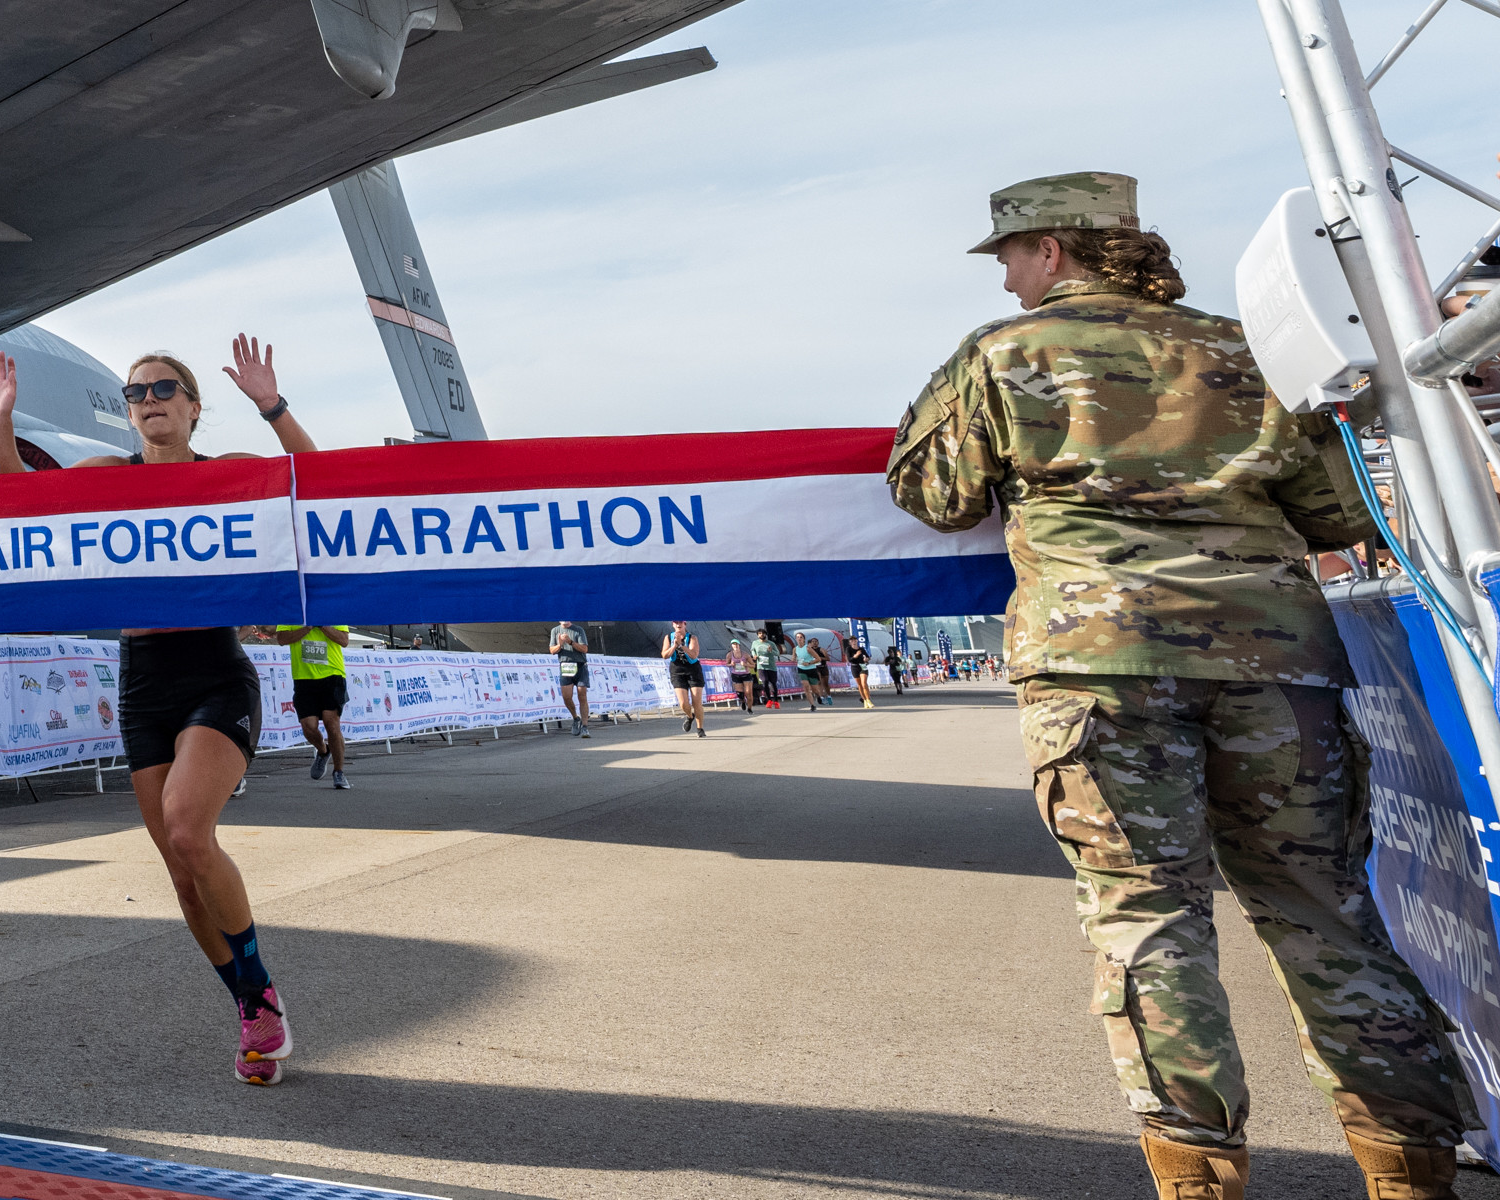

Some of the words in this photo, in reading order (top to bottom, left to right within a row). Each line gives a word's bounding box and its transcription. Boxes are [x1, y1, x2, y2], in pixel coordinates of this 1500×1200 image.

[412, 286, 431, 309] AFMC
[447, 377, 465, 412] ED
[71, 513, 257, 566] FORCE
[306, 494, 708, 558] MARATHON
[305, 646, 325, 654] 3876
[396, 679, 407, 692] AIR
[407, 676, 428, 690] FORCE
[1397, 883, 1442, 963] AND
[1431, 903, 1500, 1009] PRIDE
